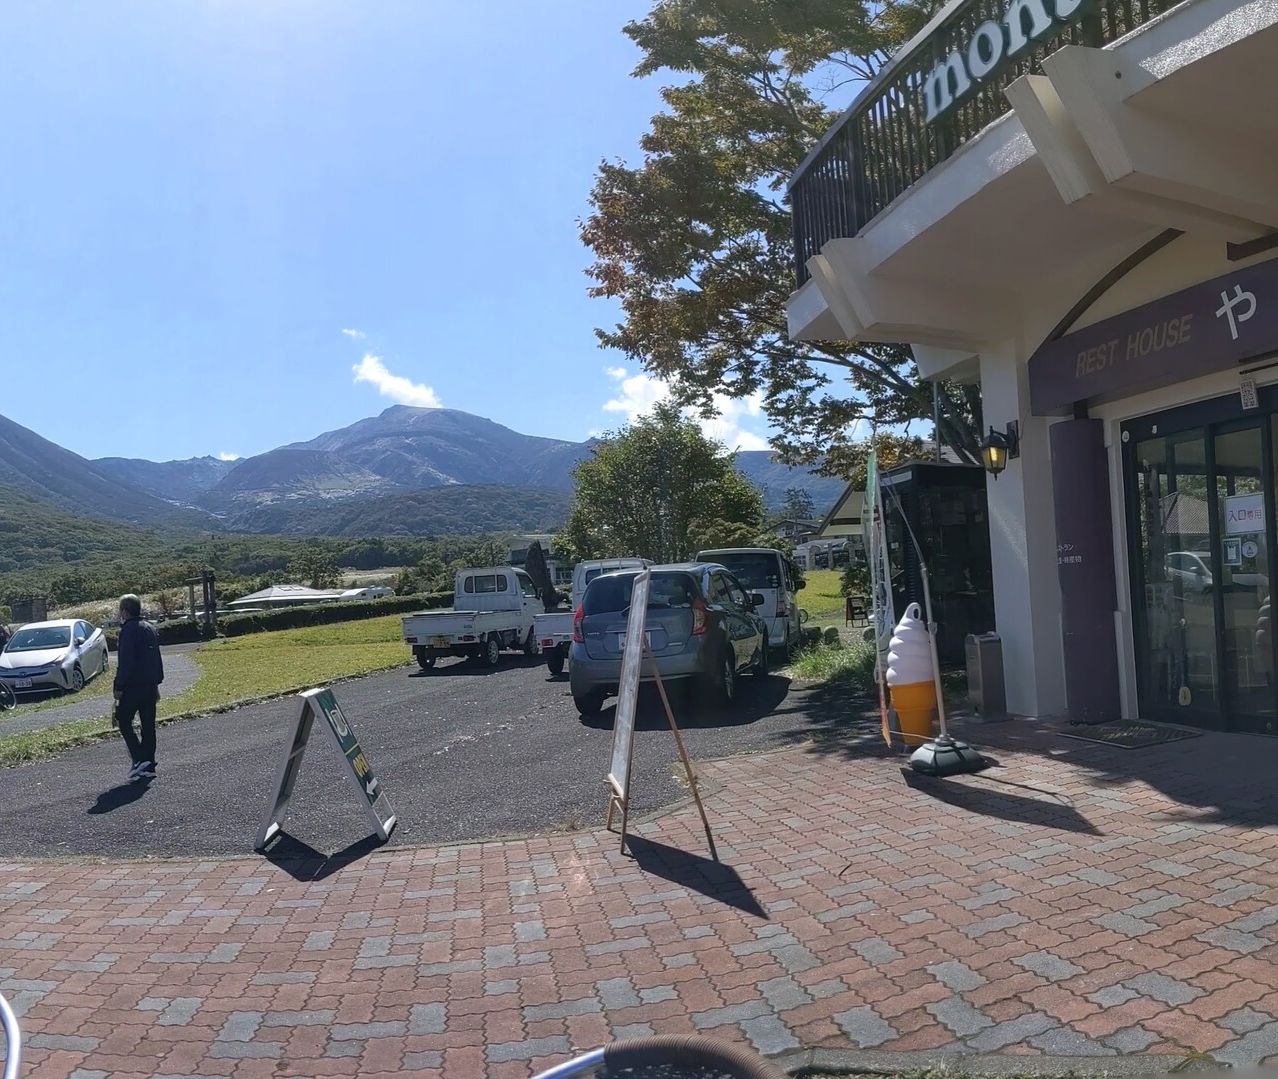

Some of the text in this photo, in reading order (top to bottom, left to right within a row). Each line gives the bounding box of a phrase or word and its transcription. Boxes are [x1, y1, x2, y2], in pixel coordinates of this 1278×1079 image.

[1215, 284, 1257, 340] や
[1075, 313, 1194, 378] REST HOUSE
